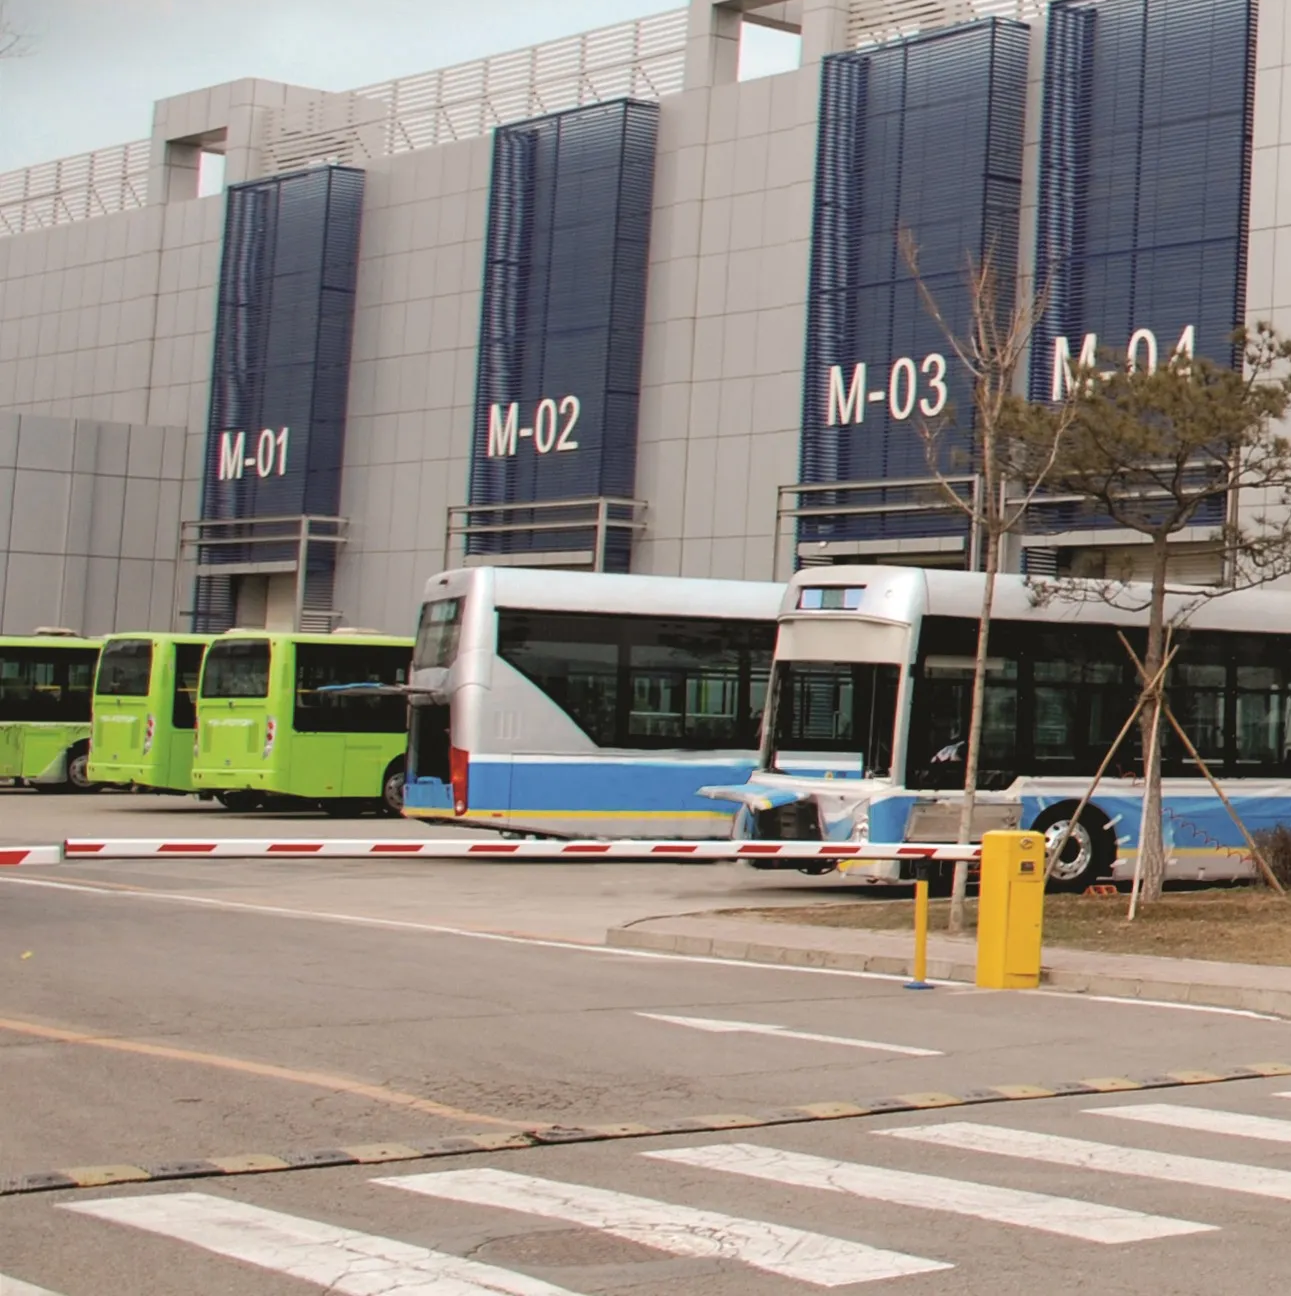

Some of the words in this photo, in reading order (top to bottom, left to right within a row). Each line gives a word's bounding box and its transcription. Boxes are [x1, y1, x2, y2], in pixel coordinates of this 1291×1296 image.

[826, 352, 948, 426] M-03
[218, 426, 290, 481] M-01
[487, 395, 581, 457] M-02
